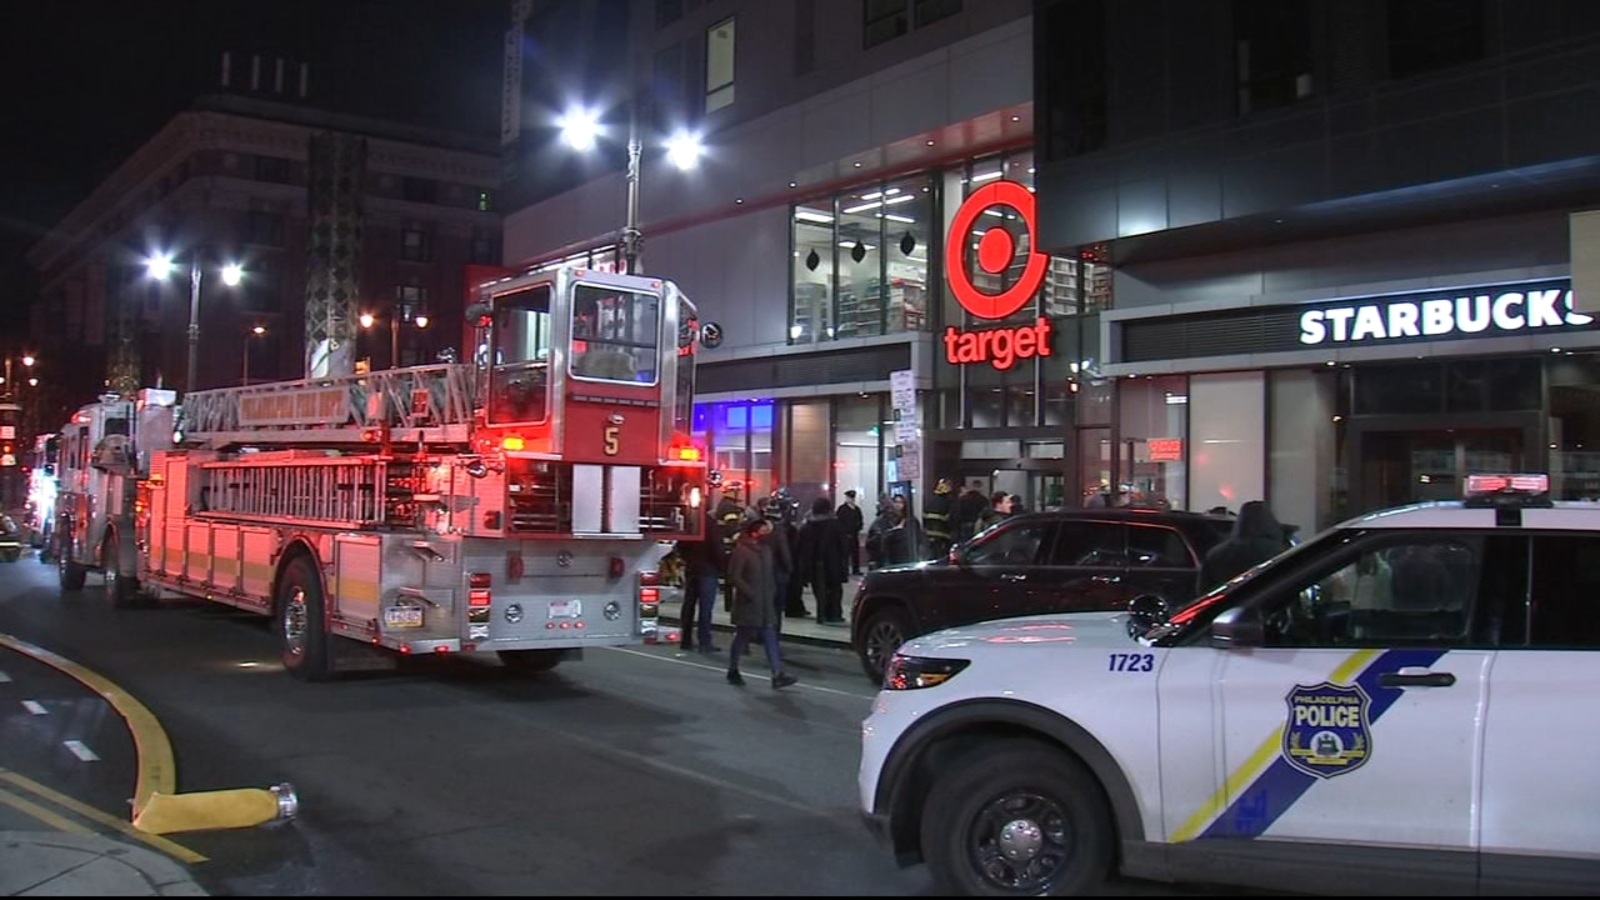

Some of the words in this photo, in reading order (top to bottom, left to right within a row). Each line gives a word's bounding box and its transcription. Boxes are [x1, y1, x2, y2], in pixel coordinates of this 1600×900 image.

[944, 317, 1051, 370] target
[604, 427, 620, 456] 5
[1109, 653, 1155, 672] 1723
[1294, 695, 1360, 705] PHILADELPHIA
[1294, 705, 1360, 728] POLICE
